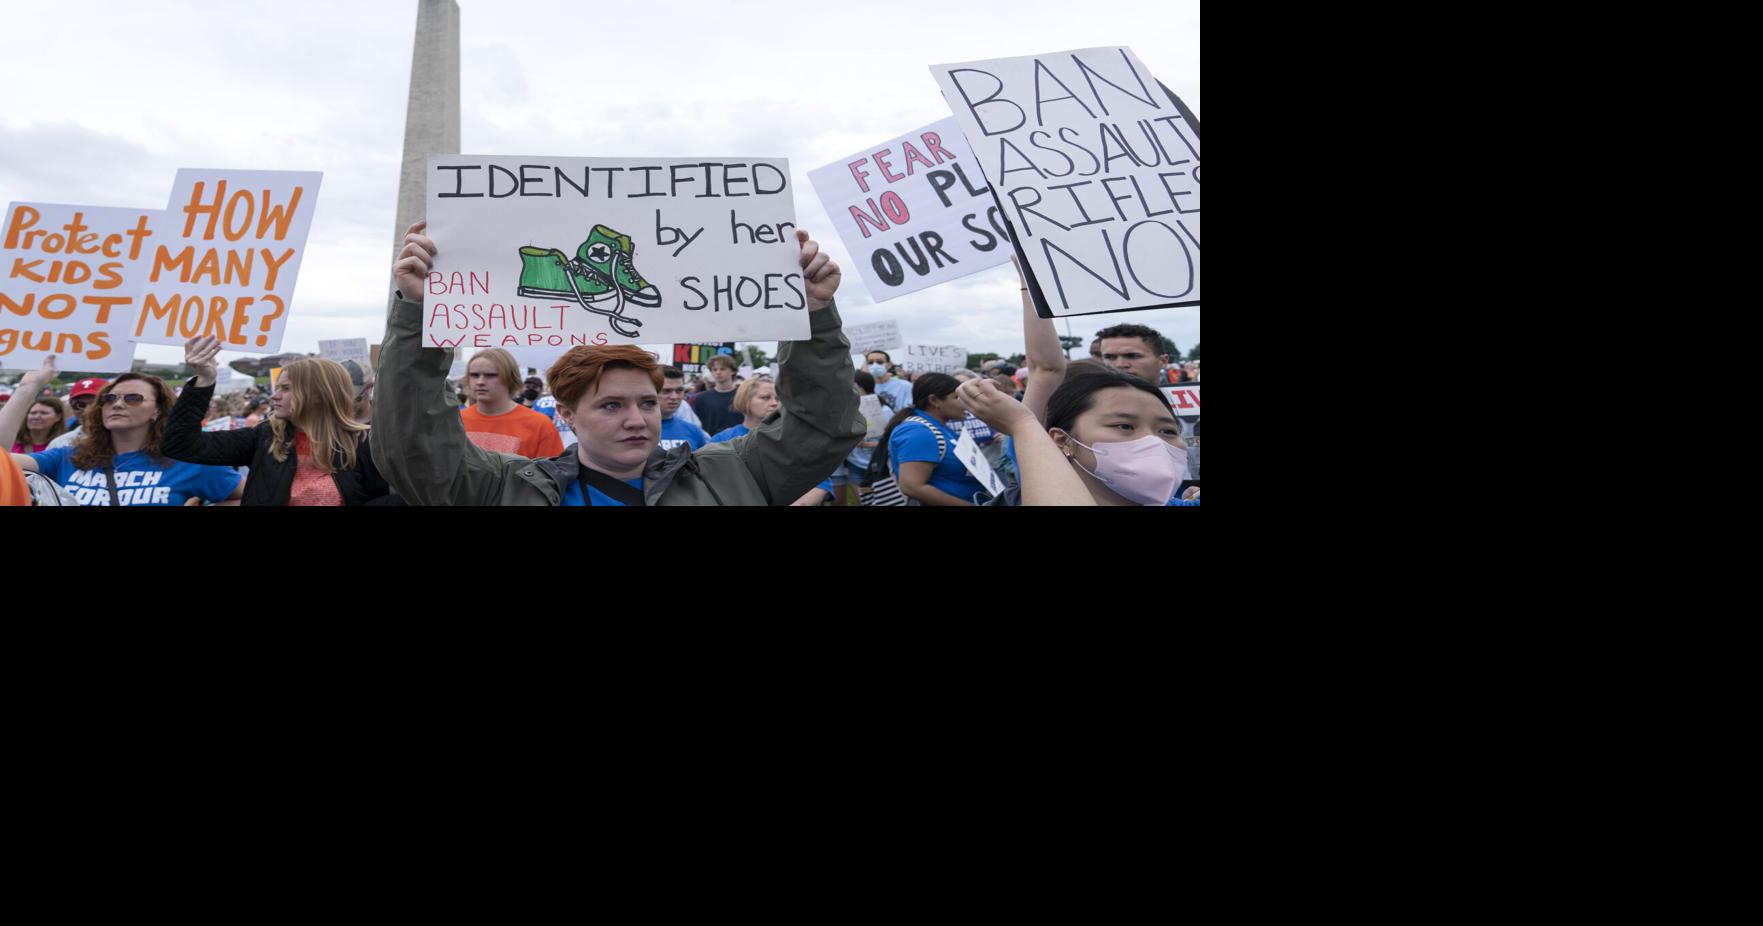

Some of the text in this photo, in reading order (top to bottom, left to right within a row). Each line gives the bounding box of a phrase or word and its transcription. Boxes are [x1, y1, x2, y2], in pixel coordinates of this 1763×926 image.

[948, 48, 1161, 137] BAN
[847, 131, 957, 193] FEAR
[1000, 114, 1200, 187] ASSAULT
[437, 162, 786, 198] IDENTIFIED
[1008, 165, 1200, 237] RIFLE
[4, 205, 152, 261] Protect
[182, 180, 303, 242] HOW
[656, 208, 796, 258] by her
[848, 190, 911, 239] NO
[10, 257, 124, 290] KIDS
[149, 245, 295, 291] MANY
[870, 229, 960, 288] OUR
[1040, 219, 1200, 310] NO
[428, 271, 489, 296] BAN
[680, 273, 806, 312] SHOES
[0, 292, 133, 324] NOT
[135, 293, 285, 347] MORE?
[429, 303, 571, 331] ASSAULT
[0, 328, 112, 360] guns
[429, 332, 609, 348] WEAPONS
[67, 470, 163, 488] MARCH
[117, 486, 171, 506] OUR
